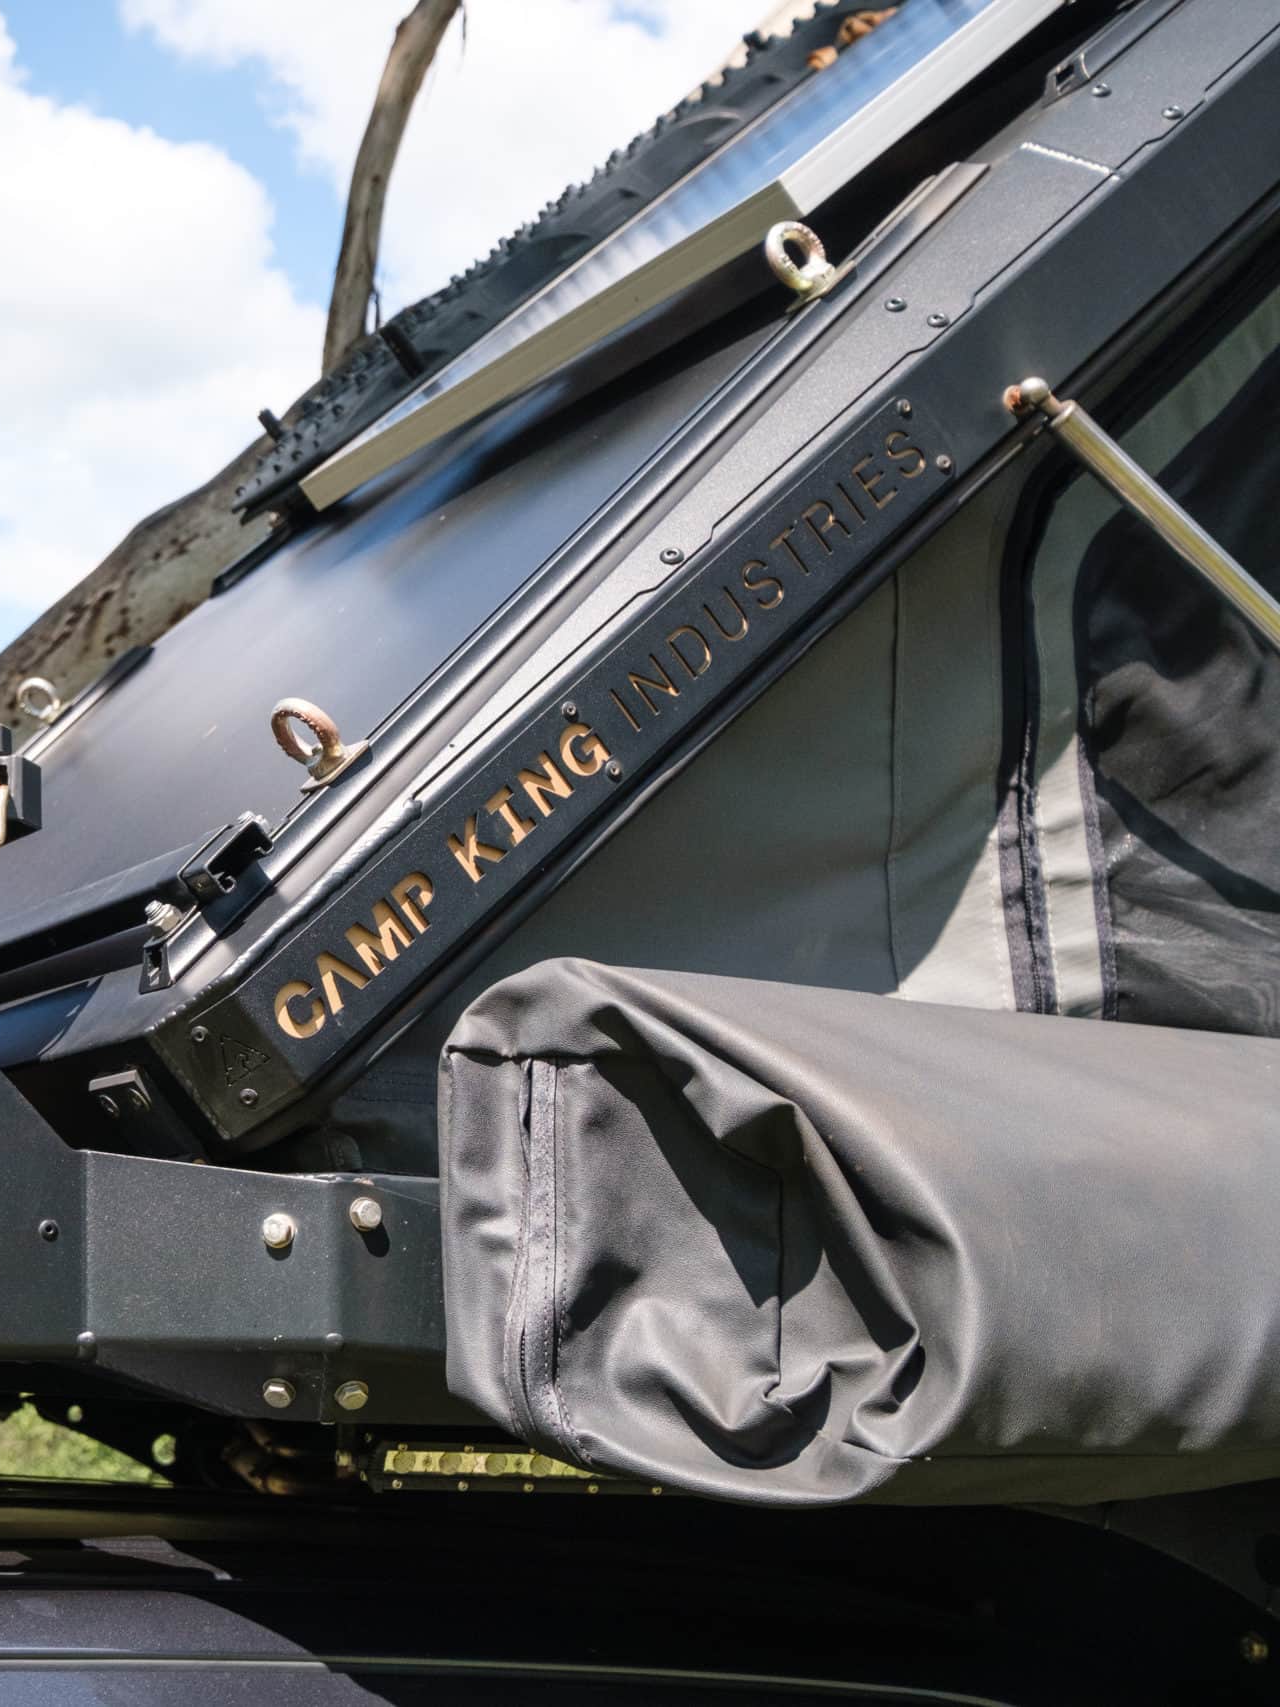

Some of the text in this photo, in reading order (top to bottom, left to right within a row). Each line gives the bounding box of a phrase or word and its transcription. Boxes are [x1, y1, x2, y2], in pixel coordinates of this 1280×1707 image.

[274, 431, 927, 1039] CAMP KING INDUSTRIES
